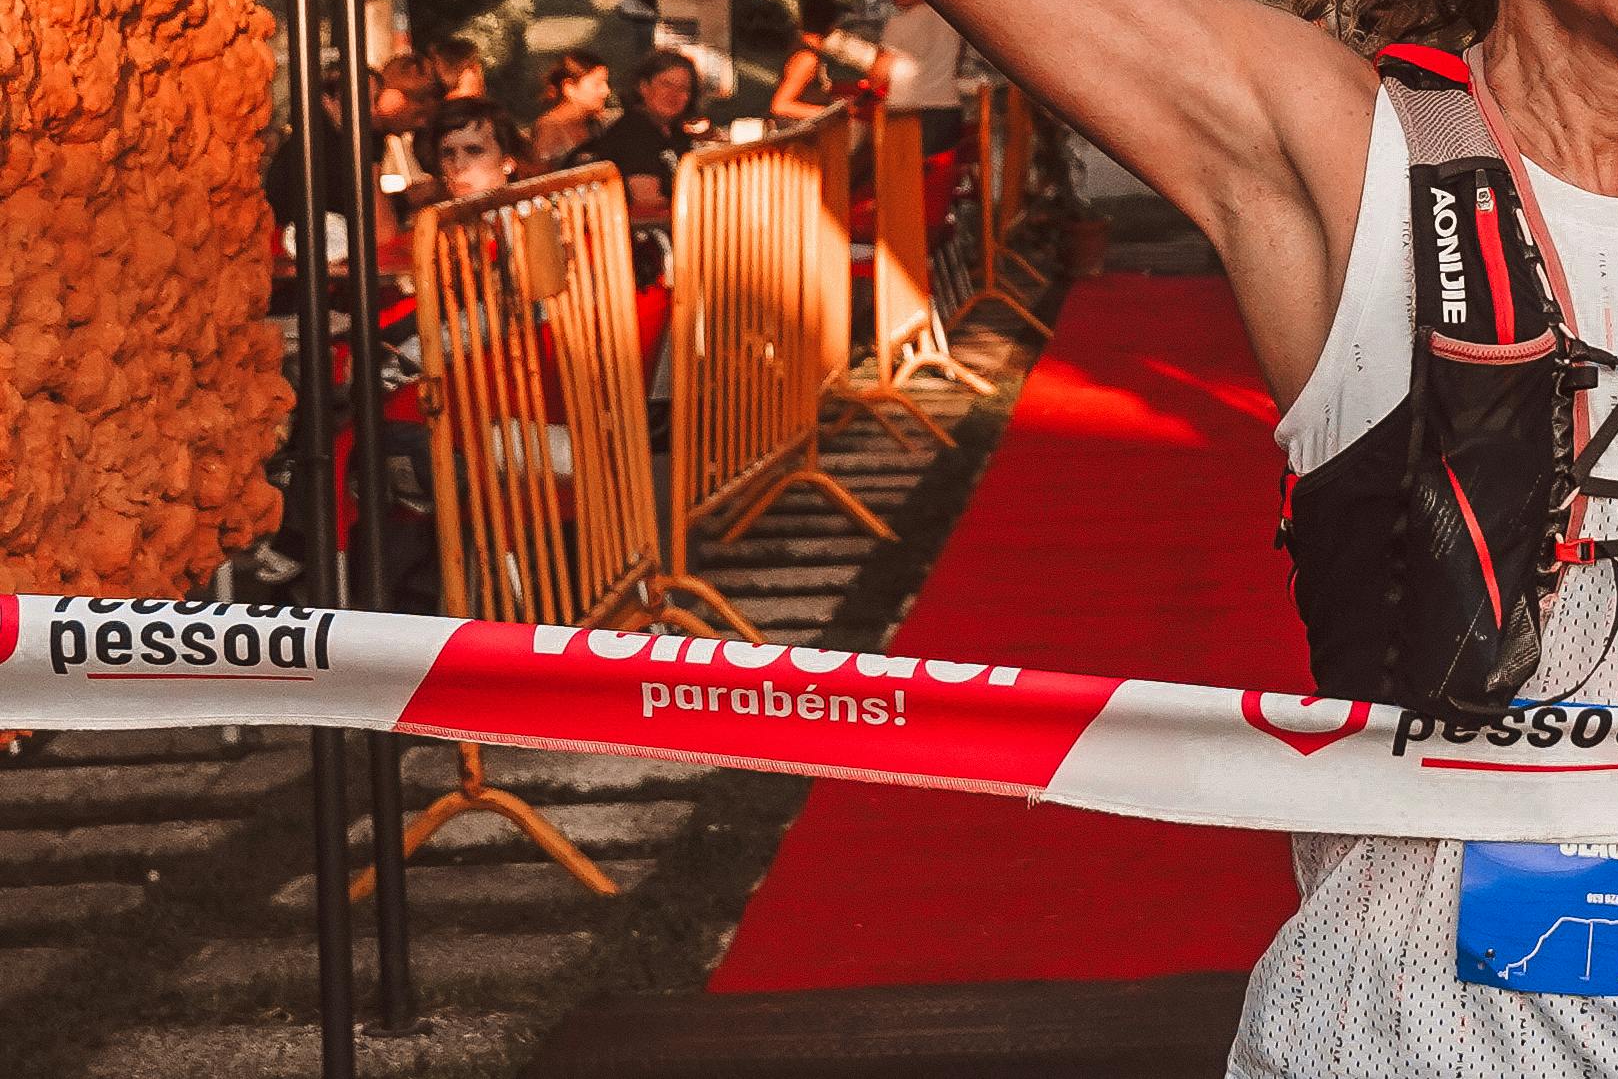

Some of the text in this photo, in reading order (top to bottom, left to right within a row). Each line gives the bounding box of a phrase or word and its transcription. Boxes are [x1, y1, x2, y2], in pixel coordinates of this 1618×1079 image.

[1429, 186, 1467, 324] AONIJIE
[49, 611, 336, 675] pessoal
[641, 680, 907, 727] parabéns!
